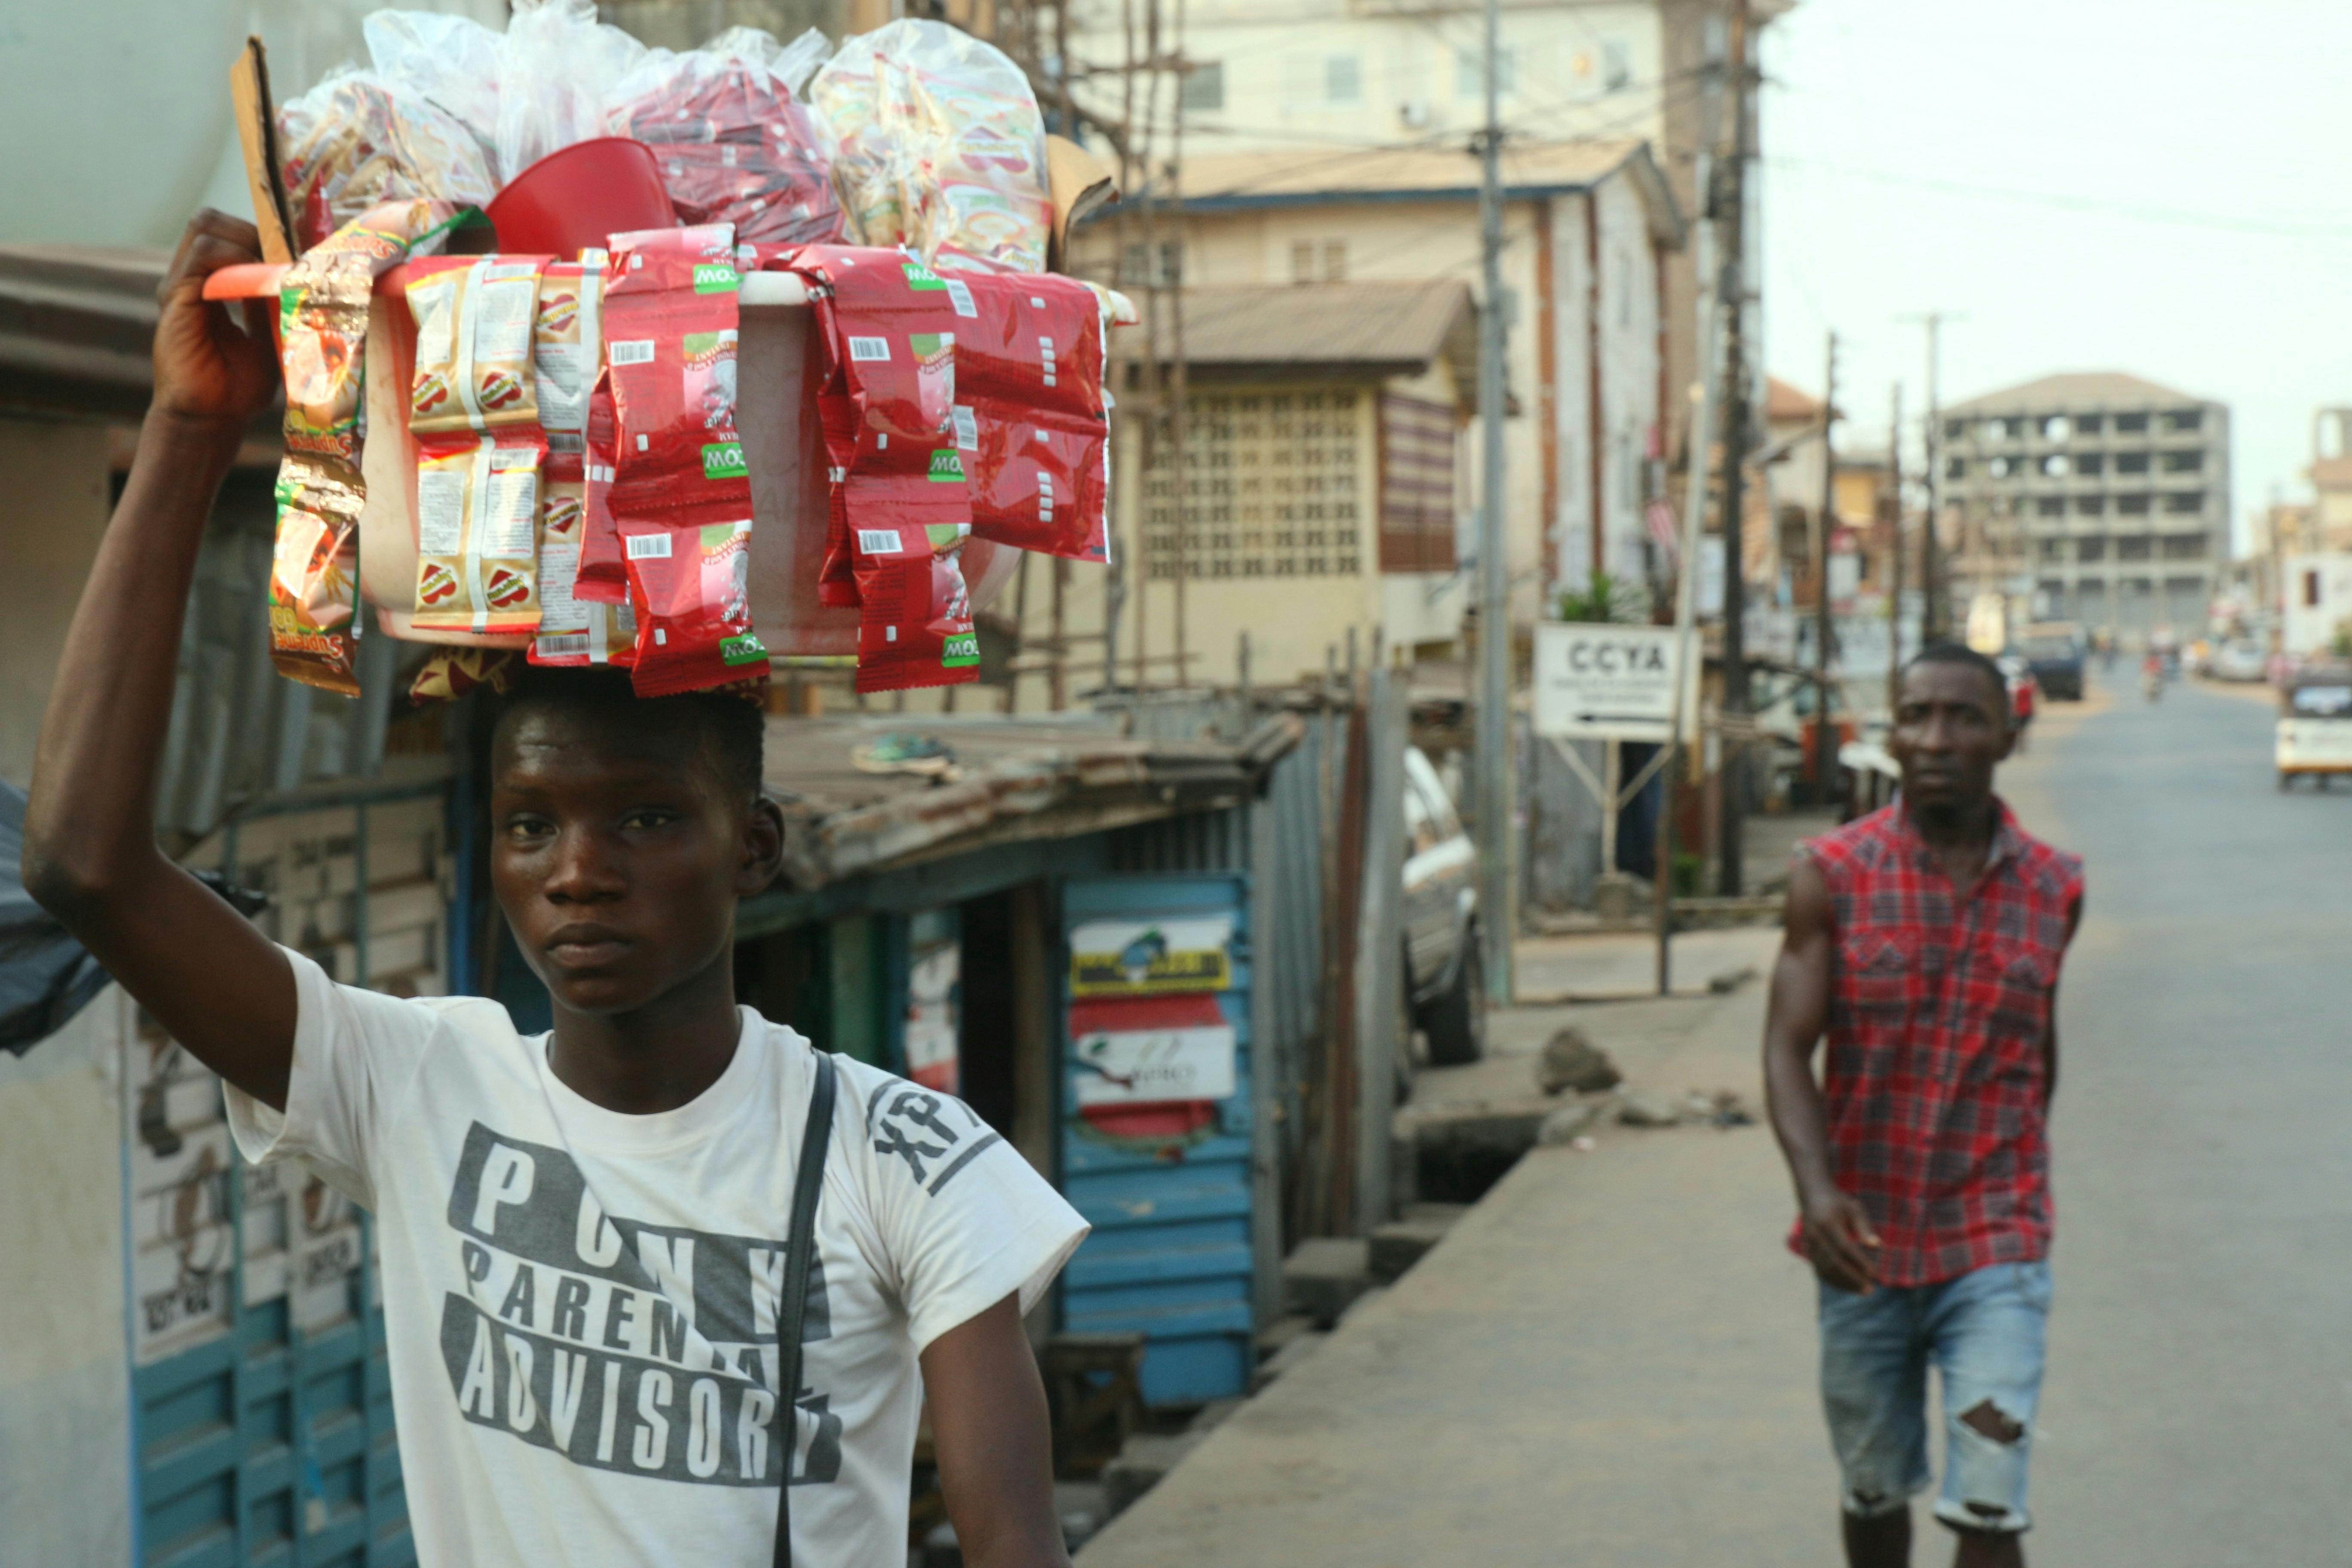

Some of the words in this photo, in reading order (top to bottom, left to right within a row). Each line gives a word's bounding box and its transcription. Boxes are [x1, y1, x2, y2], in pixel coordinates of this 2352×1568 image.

[930, 456, 963, 473] OW
[275, 630, 343, 659] Supreme
[462, 1239, 813, 1397] PARENA
[459, 1314, 820, 1479] ADVISORY
